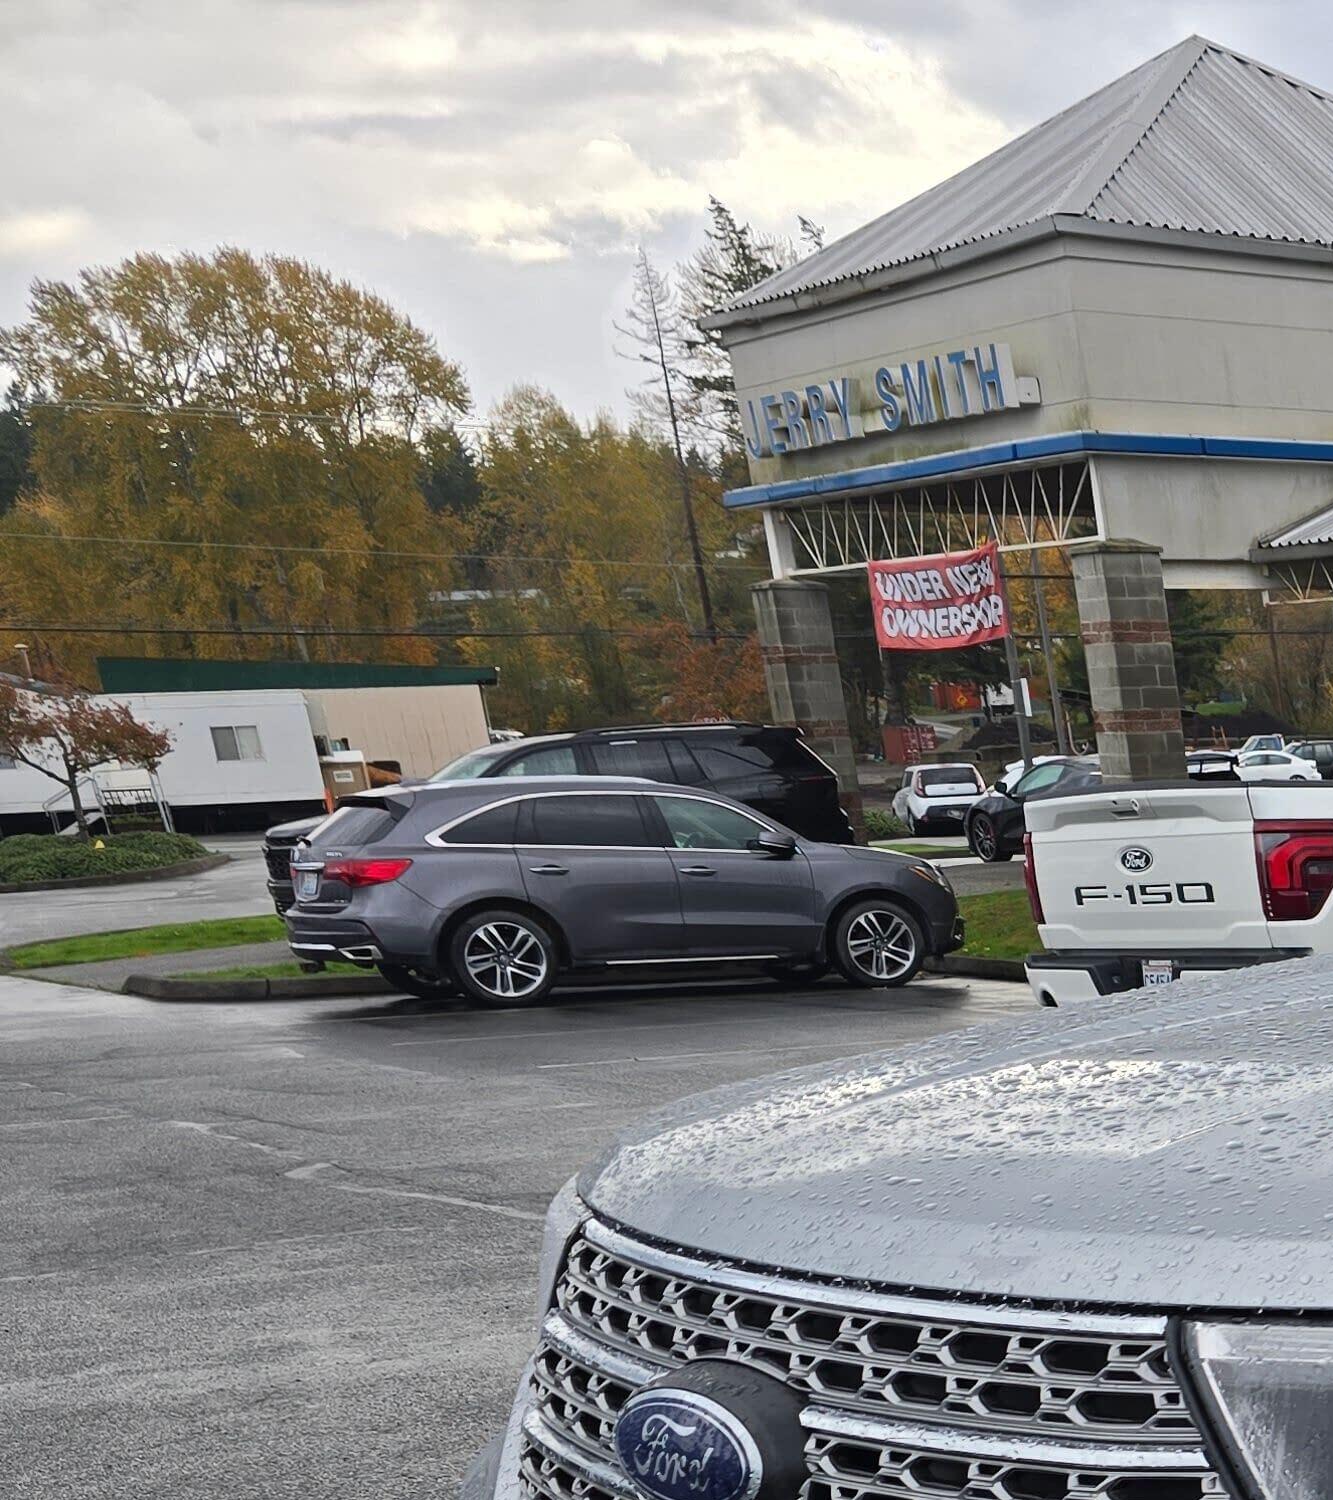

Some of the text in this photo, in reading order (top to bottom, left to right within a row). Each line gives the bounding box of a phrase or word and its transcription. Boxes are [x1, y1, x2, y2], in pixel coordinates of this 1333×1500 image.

[746, 343, 1006, 460] JERRY SMITH
[874, 569, 952, 603] UNDER
[881, 594, 1004, 639] OWNERSHIP
[1074, 882, 1216, 906] F-150
[633, 1413, 715, 1493] Ford
